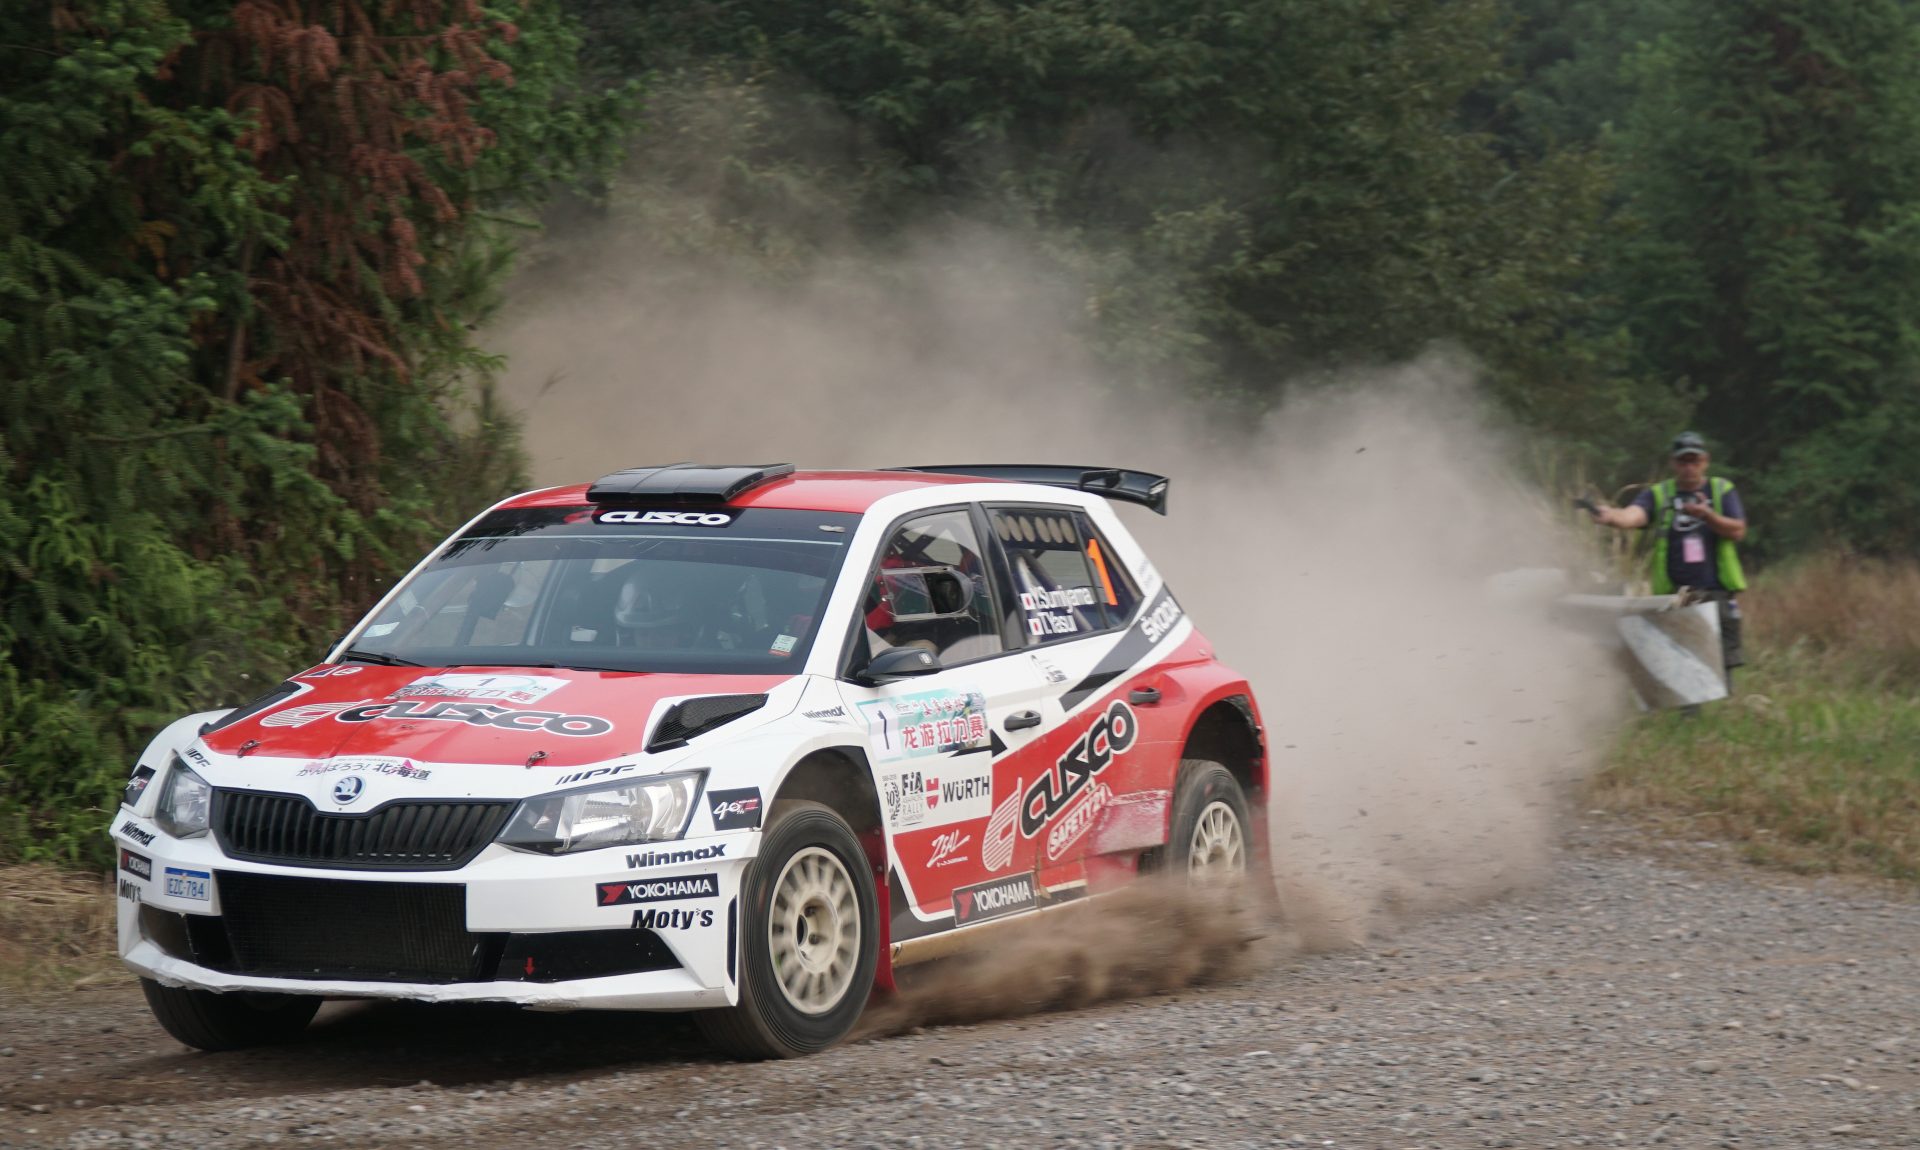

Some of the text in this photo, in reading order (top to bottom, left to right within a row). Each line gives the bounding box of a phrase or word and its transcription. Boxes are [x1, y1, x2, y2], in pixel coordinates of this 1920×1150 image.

[599, 510, 732, 527] CUSCO
[335, 700, 613, 737] CUSCO
[902, 715, 985, 749] 龙游拉力赛
[1020, 700, 1138, 839] CUSCO
[626, 844, 727, 869] Winmax
[627, 879, 712, 898] YOKOHAMA
[973, 881, 1032, 911] YOKOHAMA
[631, 909, 714, 930] Moty's
